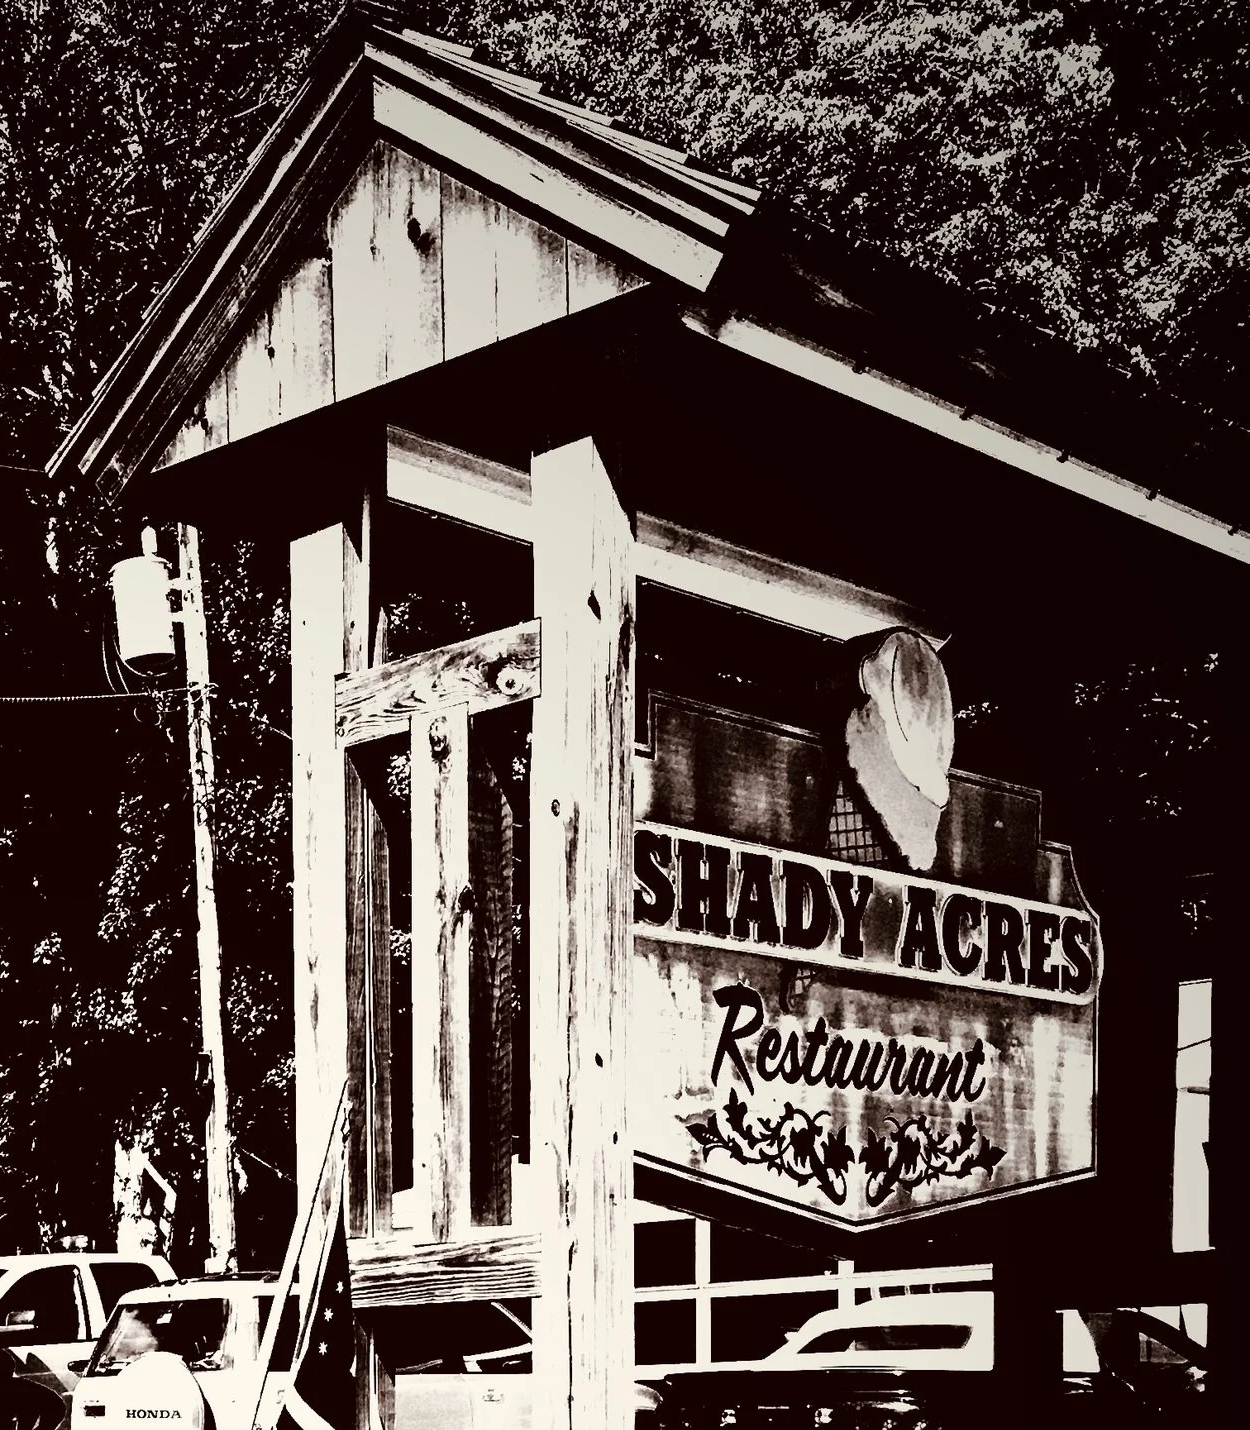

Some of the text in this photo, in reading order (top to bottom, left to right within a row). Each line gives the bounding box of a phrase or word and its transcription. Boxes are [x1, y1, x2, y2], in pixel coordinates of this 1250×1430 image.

[633, 829, 1093, 995] SHADY ACRES
[711, 981, 987, 1103] Restaurant
[125, 1409, 182, 1419] HONDA
